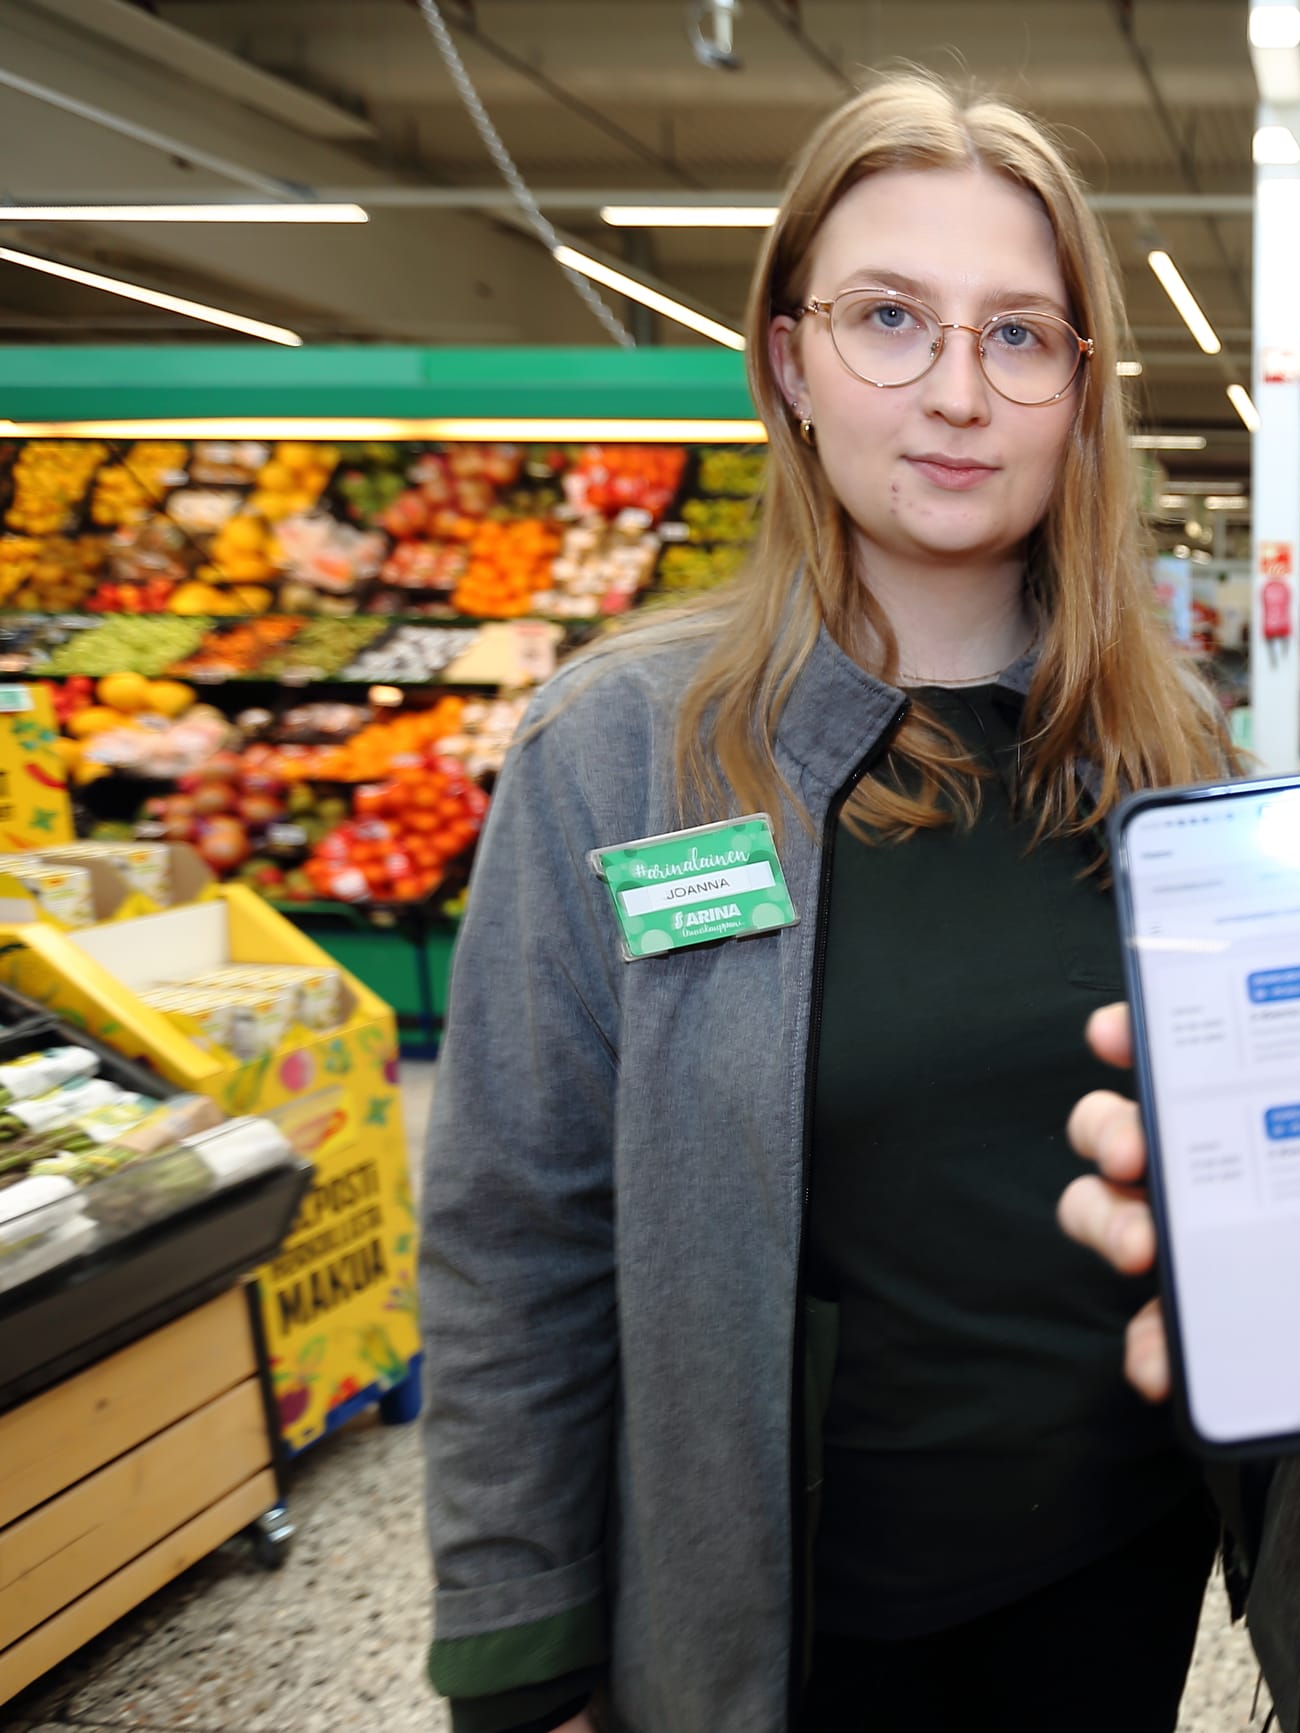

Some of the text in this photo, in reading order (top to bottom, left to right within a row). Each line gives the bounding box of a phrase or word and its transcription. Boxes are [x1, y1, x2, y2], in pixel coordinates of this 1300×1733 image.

[667, 878, 730, 900] JOANNA
[686, 903, 743, 927] ARINA
[278, 1237, 389, 1335] MAKUA
